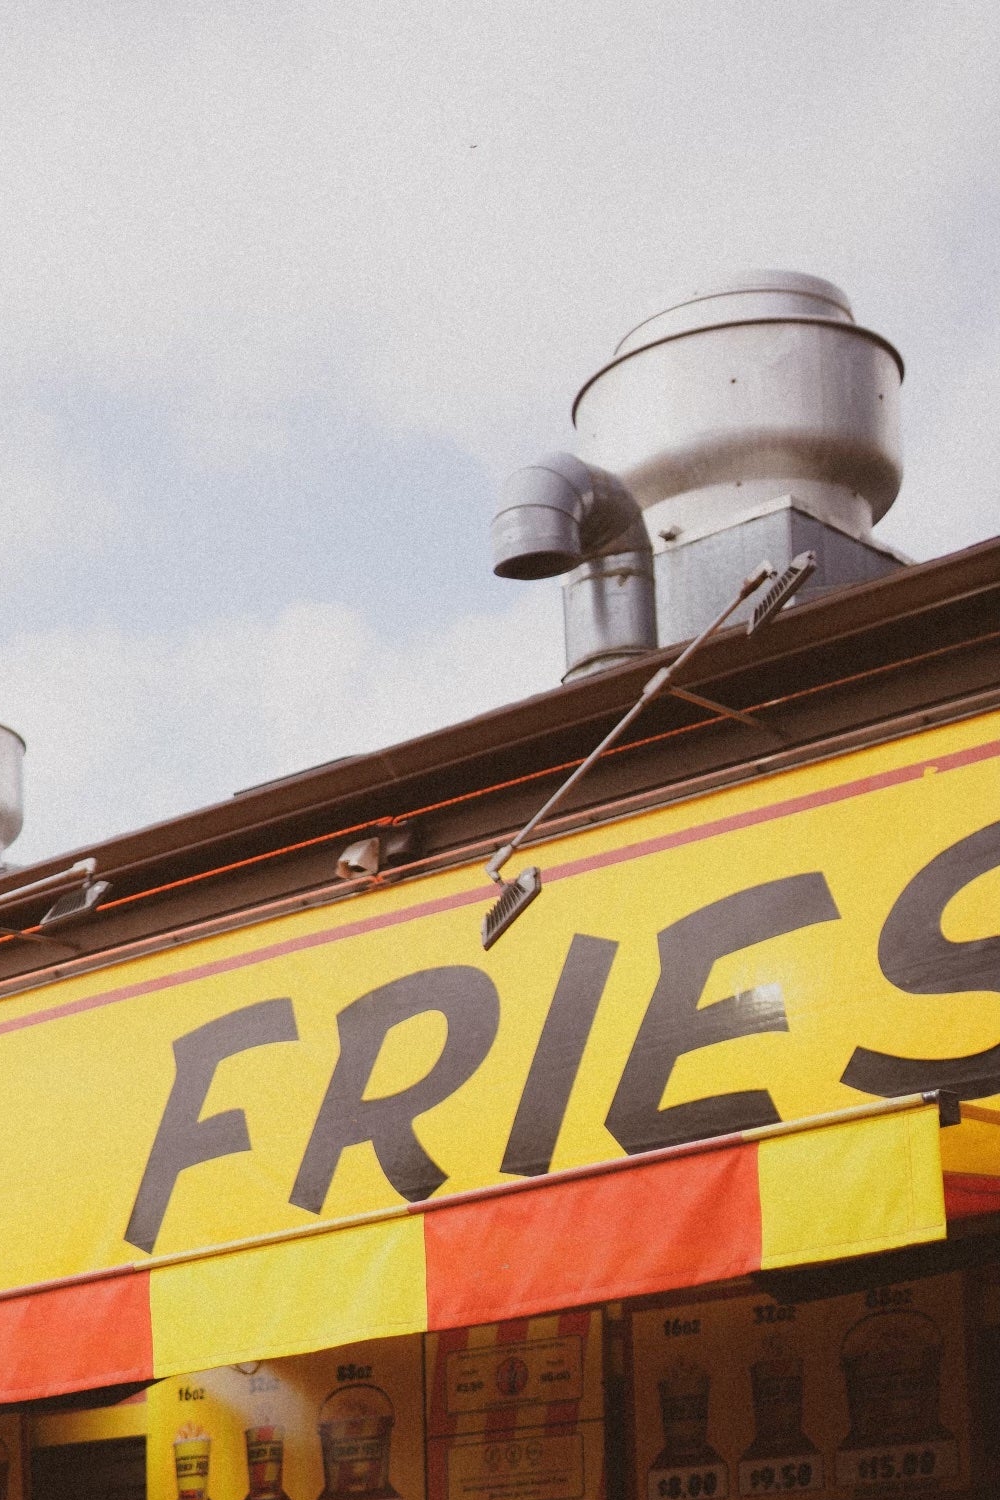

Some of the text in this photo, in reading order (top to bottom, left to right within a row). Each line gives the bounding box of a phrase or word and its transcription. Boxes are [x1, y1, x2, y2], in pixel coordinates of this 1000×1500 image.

[123, 820, 1000, 1253] FRIES
[753, 1304, 797, 1324] 32oz
[664, 1319, 700, 1337] 16oz
[178, 1387, 205, 1401] 16oz
[750, 1463, 812, 1490] $9.50
[859, 1451, 936, 1480] $15.00
[658, 1472, 717, 1499] $8.00
